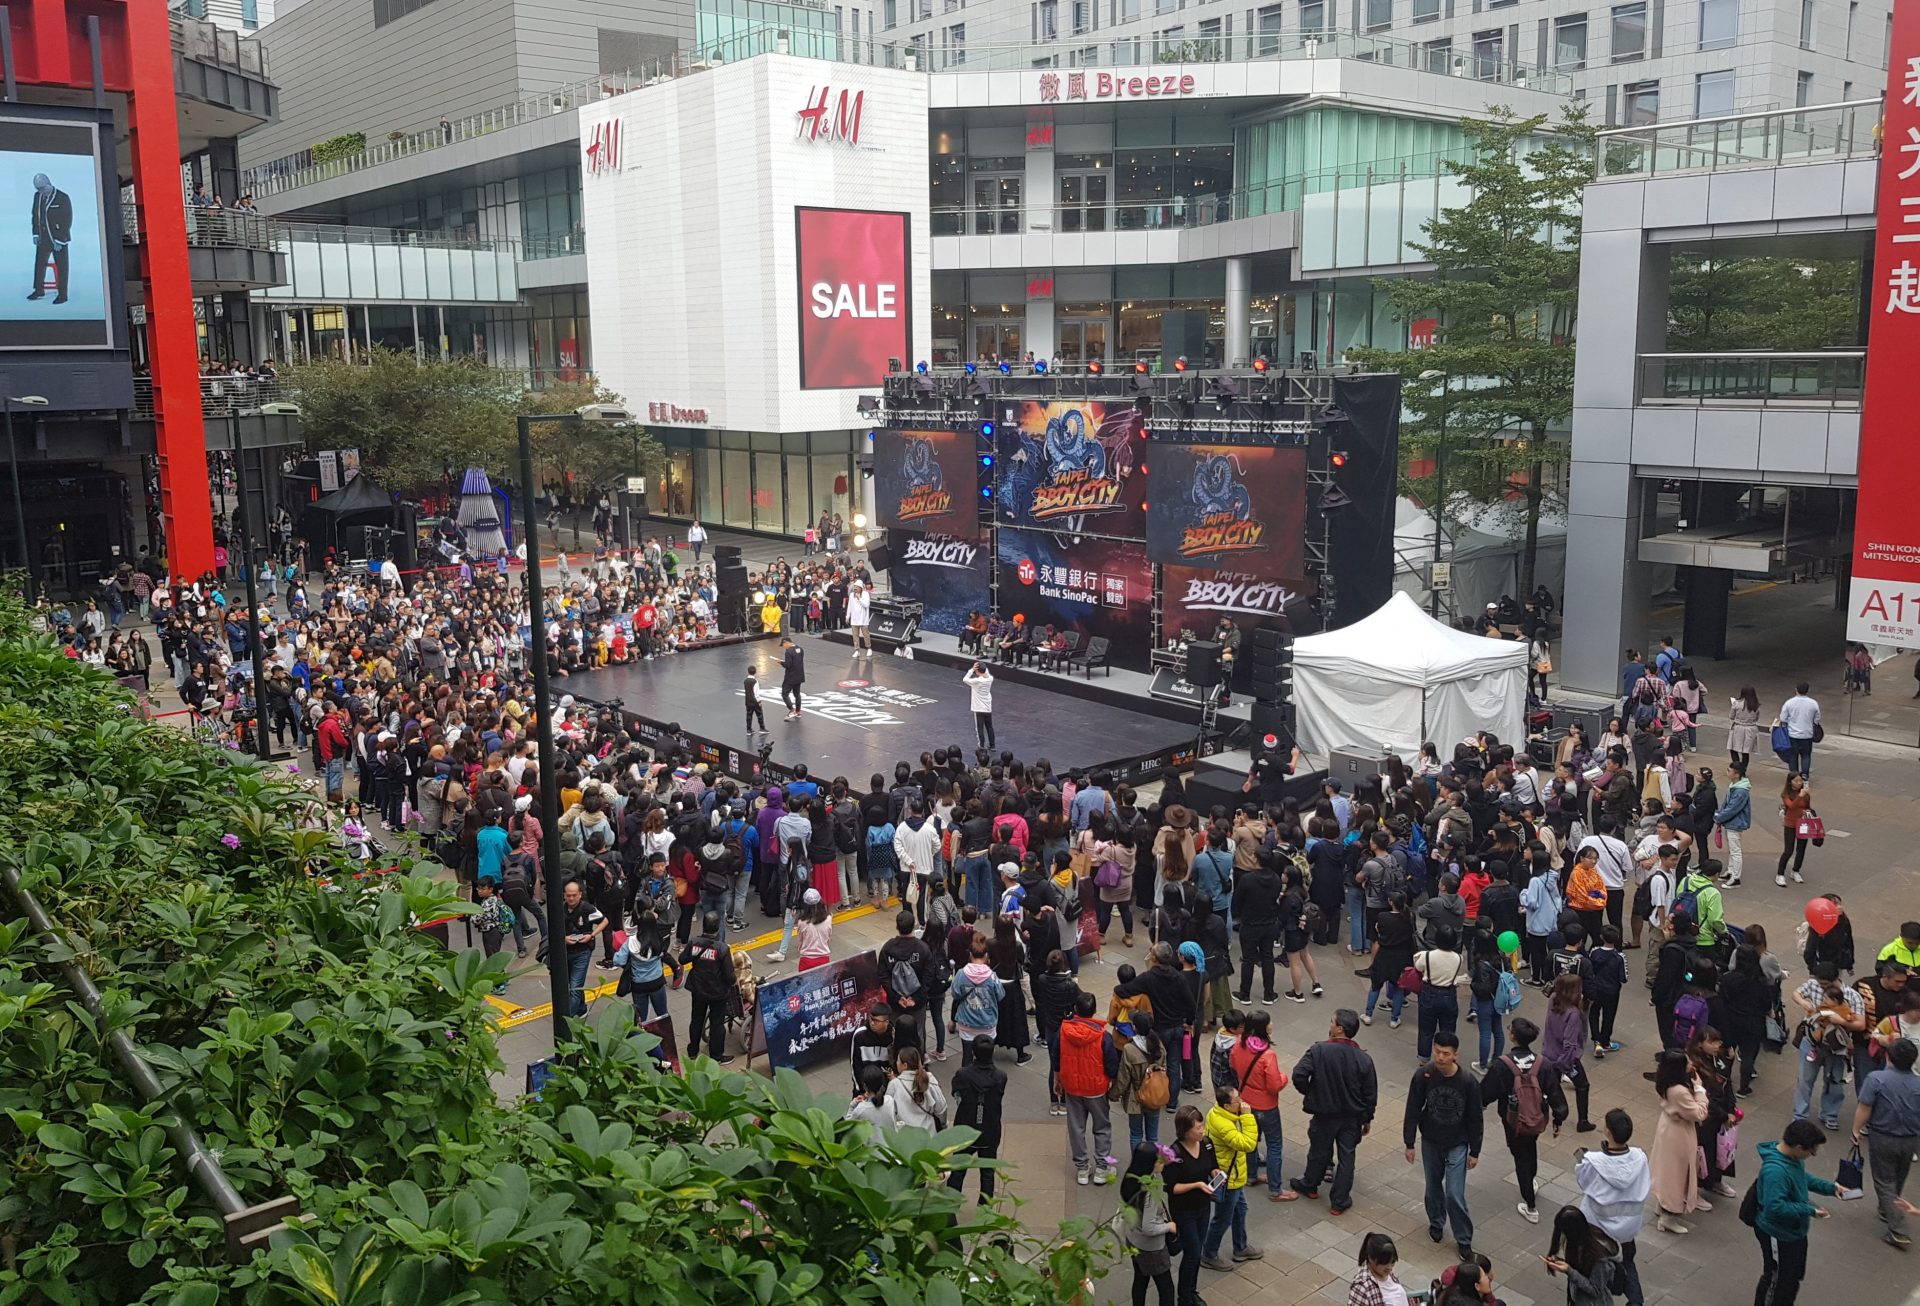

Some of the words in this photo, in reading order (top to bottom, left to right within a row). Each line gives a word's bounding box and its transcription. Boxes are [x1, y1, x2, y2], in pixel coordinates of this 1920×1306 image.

[1039, 72, 1087, 101] 微風
[1096, 72, 1195, 97] Breeze
[797, 85, 864, 145] H&M
[586, 117, 621, 174] H&M
[811, 282, 896, 319] SALE
[560, 351, 577, 367] SAL
[1054, 468, 1090, 485] TAIPEI
[1031, 481, 1080, 512] BBOY
[1079, 479, 1120, 505] CITY
[1203, 511, 1235, 526] TAIPEI
[1180, 526, 1226, 550] BBOY
[1224, 520, 1264, 545] CITY
[1868, 542, 1895, 552] SHIN
[902, 538, 943, 561] BBOY
[942, 540, 977, 565] CITY
[1862, 552, 1920, 564] MITSUKOS
[1040, 564, 1098, 590] 永豐銀行
[1040, 585, 1060, 599] Bank
[1062, 589, 1098, 605] SinoPac
[1179, 577, 1245, 608] BBOY
[1242, 581, 1296, 613] CITY
[1859, 589, 1920, 625] A11
[1140, 757, 1162, 771] HRC
